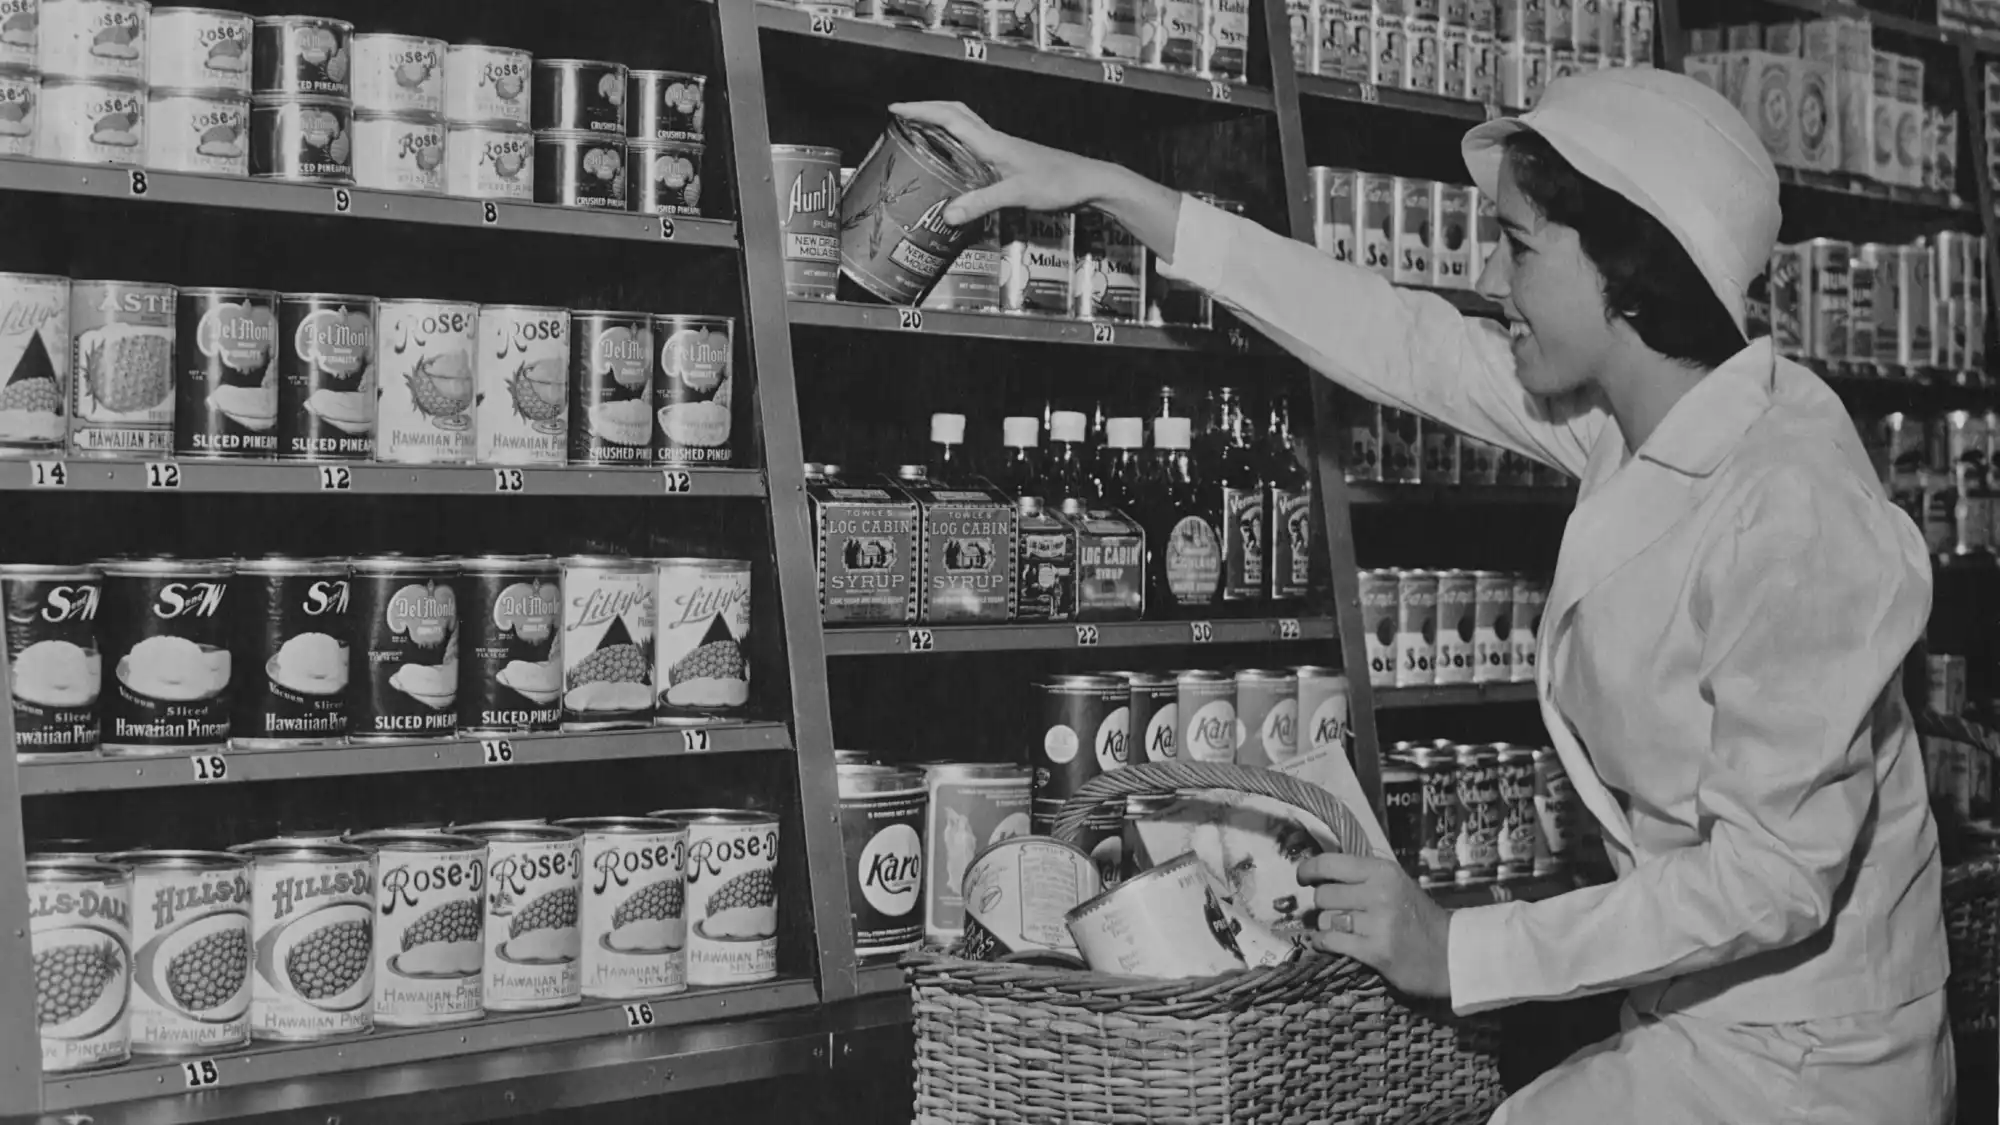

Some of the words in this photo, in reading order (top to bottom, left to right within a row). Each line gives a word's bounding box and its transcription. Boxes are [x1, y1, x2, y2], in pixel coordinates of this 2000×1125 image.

[812, 18, 834, 34] 20
[657, 129, 686, 140] CRUSHED
[132, 172, 148, 194] 8
[336, 190, 349, 211] 9
[576, 196, 606, 206] CRUSHED
[784, 168, 827, 227] Aunt
[484, 202, 497, 223] 8
[662, 218, 674, 238] 9
[795, 235, 817, 246] NEW
[907, 244, 926, 262] NEW
[902, 311, 922, 329] 20
[601, 339, 626, 360] Del
[89, 431, 144, 448] HAWAIIAN
[193, 433, 240, 449] SLICED
[291, 437, 336, 451] SLICED
[392, 429, 450, 447] HAWAIIAN
[493, 432, 549, 450] HAWAIIAN
[589, 447, 635, 460] CRUSHED
[658, 447, 705, 461] CRUSHED
[37, 463, 66, 485] 14
[150, 464, 180, 487] 12
[323, 468, 351, 489] 12
[498, 470, 523, 491] 13
[668, 473, 691, 493] 12
[828, 520, 858, 535] LOG
[861, 520, 910, 534] CABIN
[931, 521, 958, 536] LOG
[961, 521, 1008, 536] CABIN
[1081, 547, 1102, 566] LOG
[1104, 546, 1140, 566] CABIN
[831, 574, 905, 589] SYRUP
[932, 574, 1004, 589] SYRUP
[395, 597, 421, 618] Del
[503, 596, 528, 616] Del
[1078, 627, 1097, 644] 22
[1193, 624, 1211, 641] 30
[1283, 621, 1299, 638] 22
[912, 632, 932, 650] 42
[118, 684, 156, 709] Vacuum
[267, 681, 304, 704] Vacuum
[55, 712, 91, 724] Sliced
[166, 706, 209, 718] Sliced
[482, 710, 529, 725] SLICED
[115, 717, 185, 739] Hawaiian
[265, 712, 328, 732] Hawaiian
[374, 714, 423, 730] SLICED
[16, 725, 71, 746] awaiian
[686, 729, 708, 750] 17
[488, 741, 513, 763] 16
[196, 756, 227, 780] 19
[690, 949, 752, 964] HAWAIIAN
[597, 963, 660, 978] HAWAIIAN
[493, 973, 557, 989] HAWAIIAN
[384, 986, 451, 1002] HAWAIIAN
[264, 1013, 335, 1029] HAWAIIAN
[628, 1003, 653, 1026] 16
[145, 1026, 217, 1042] HAWAIIAN
[187, 1060, 218, 1087] 15
